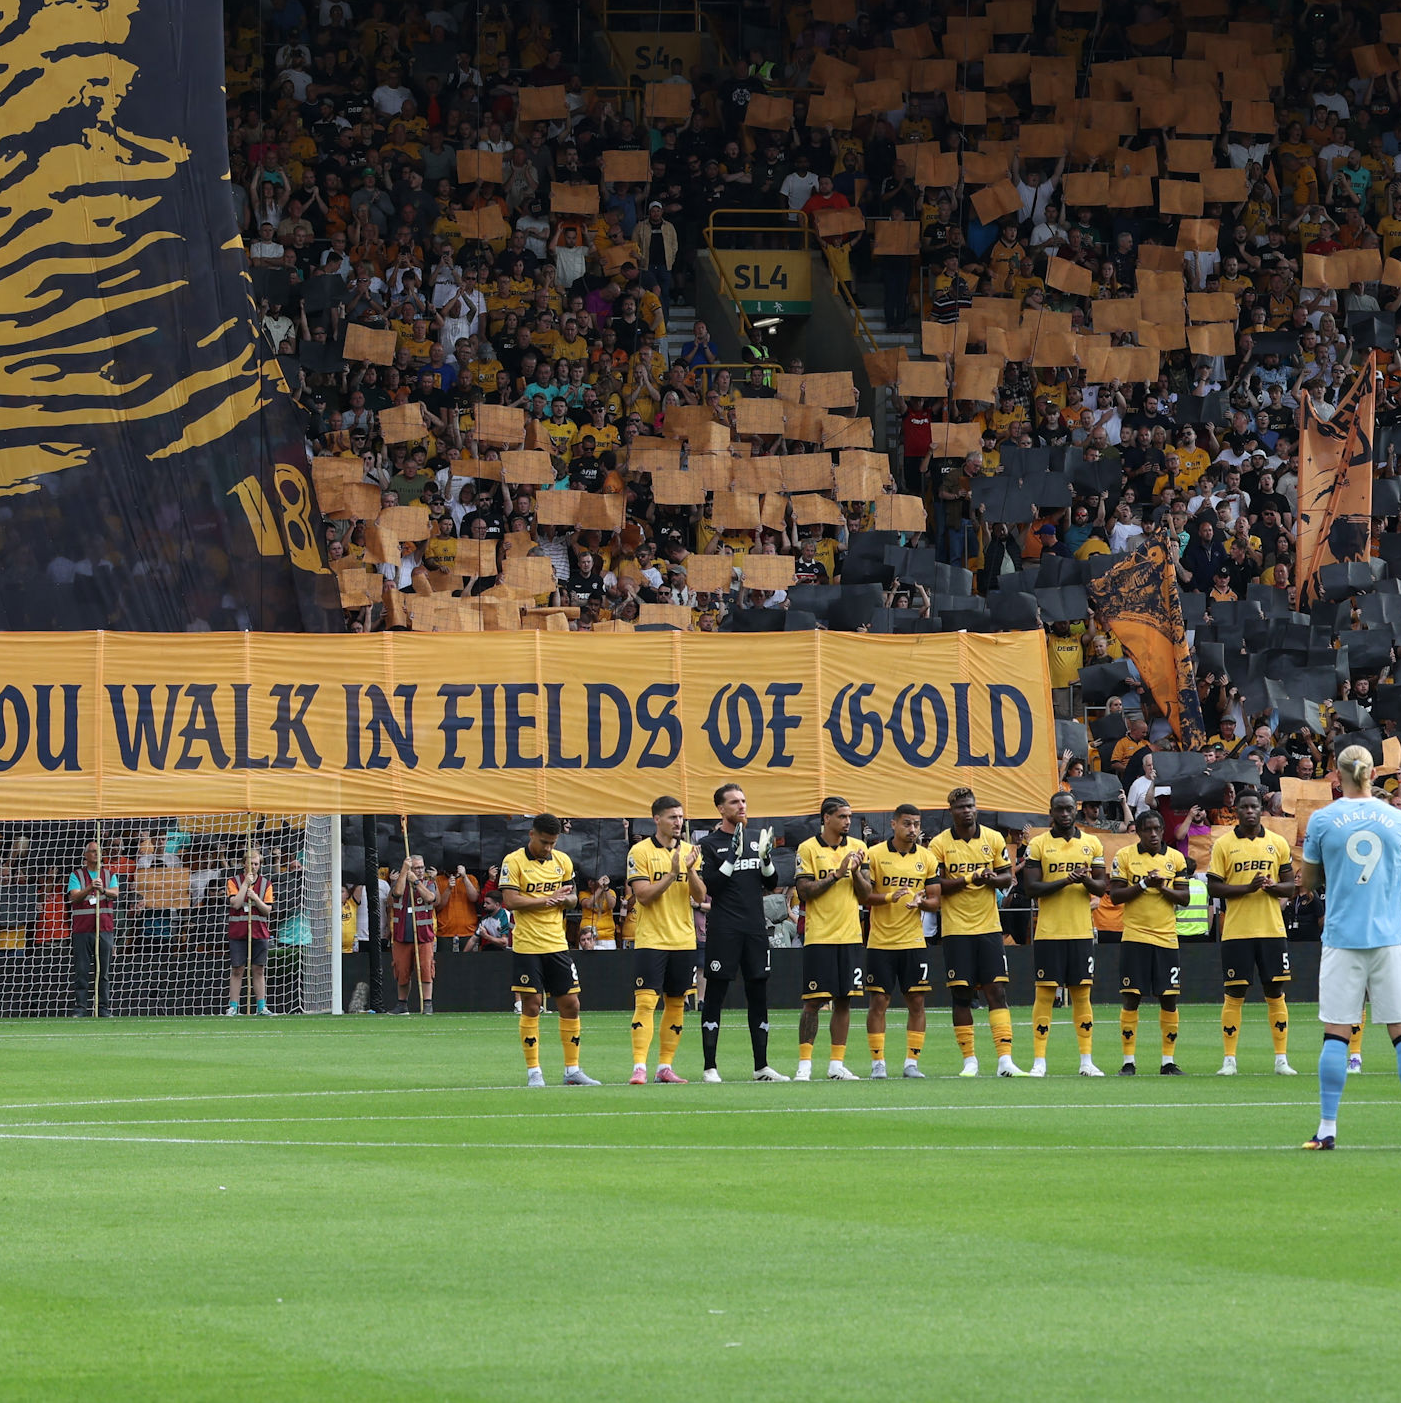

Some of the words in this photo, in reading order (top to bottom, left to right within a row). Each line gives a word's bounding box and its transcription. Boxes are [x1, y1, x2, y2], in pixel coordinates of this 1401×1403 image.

[636, 46, 669, 70] S4
[734, 264, 788, 290] SL4
[226, 462, 333, 575] 18
[104, 684, 323, 770] WALK
[342, 683, 419, 771] IN
[437, 683, 683, 771] FIELDS
[700, 683, 803, 770] OF
[823, 682, 1034, 769] GOLD
[1332, 810, 1395, 829] HAALAND
[1234, 861, 1274, 873] DEBET
[1346, 830, 1383, 885] 9
[526, 882, 562, 894] DEBET
[882, 876, 922, 888] DEBET
[1283, 953, 1290, 970] 5
[919, 963, 928, 980] 7
